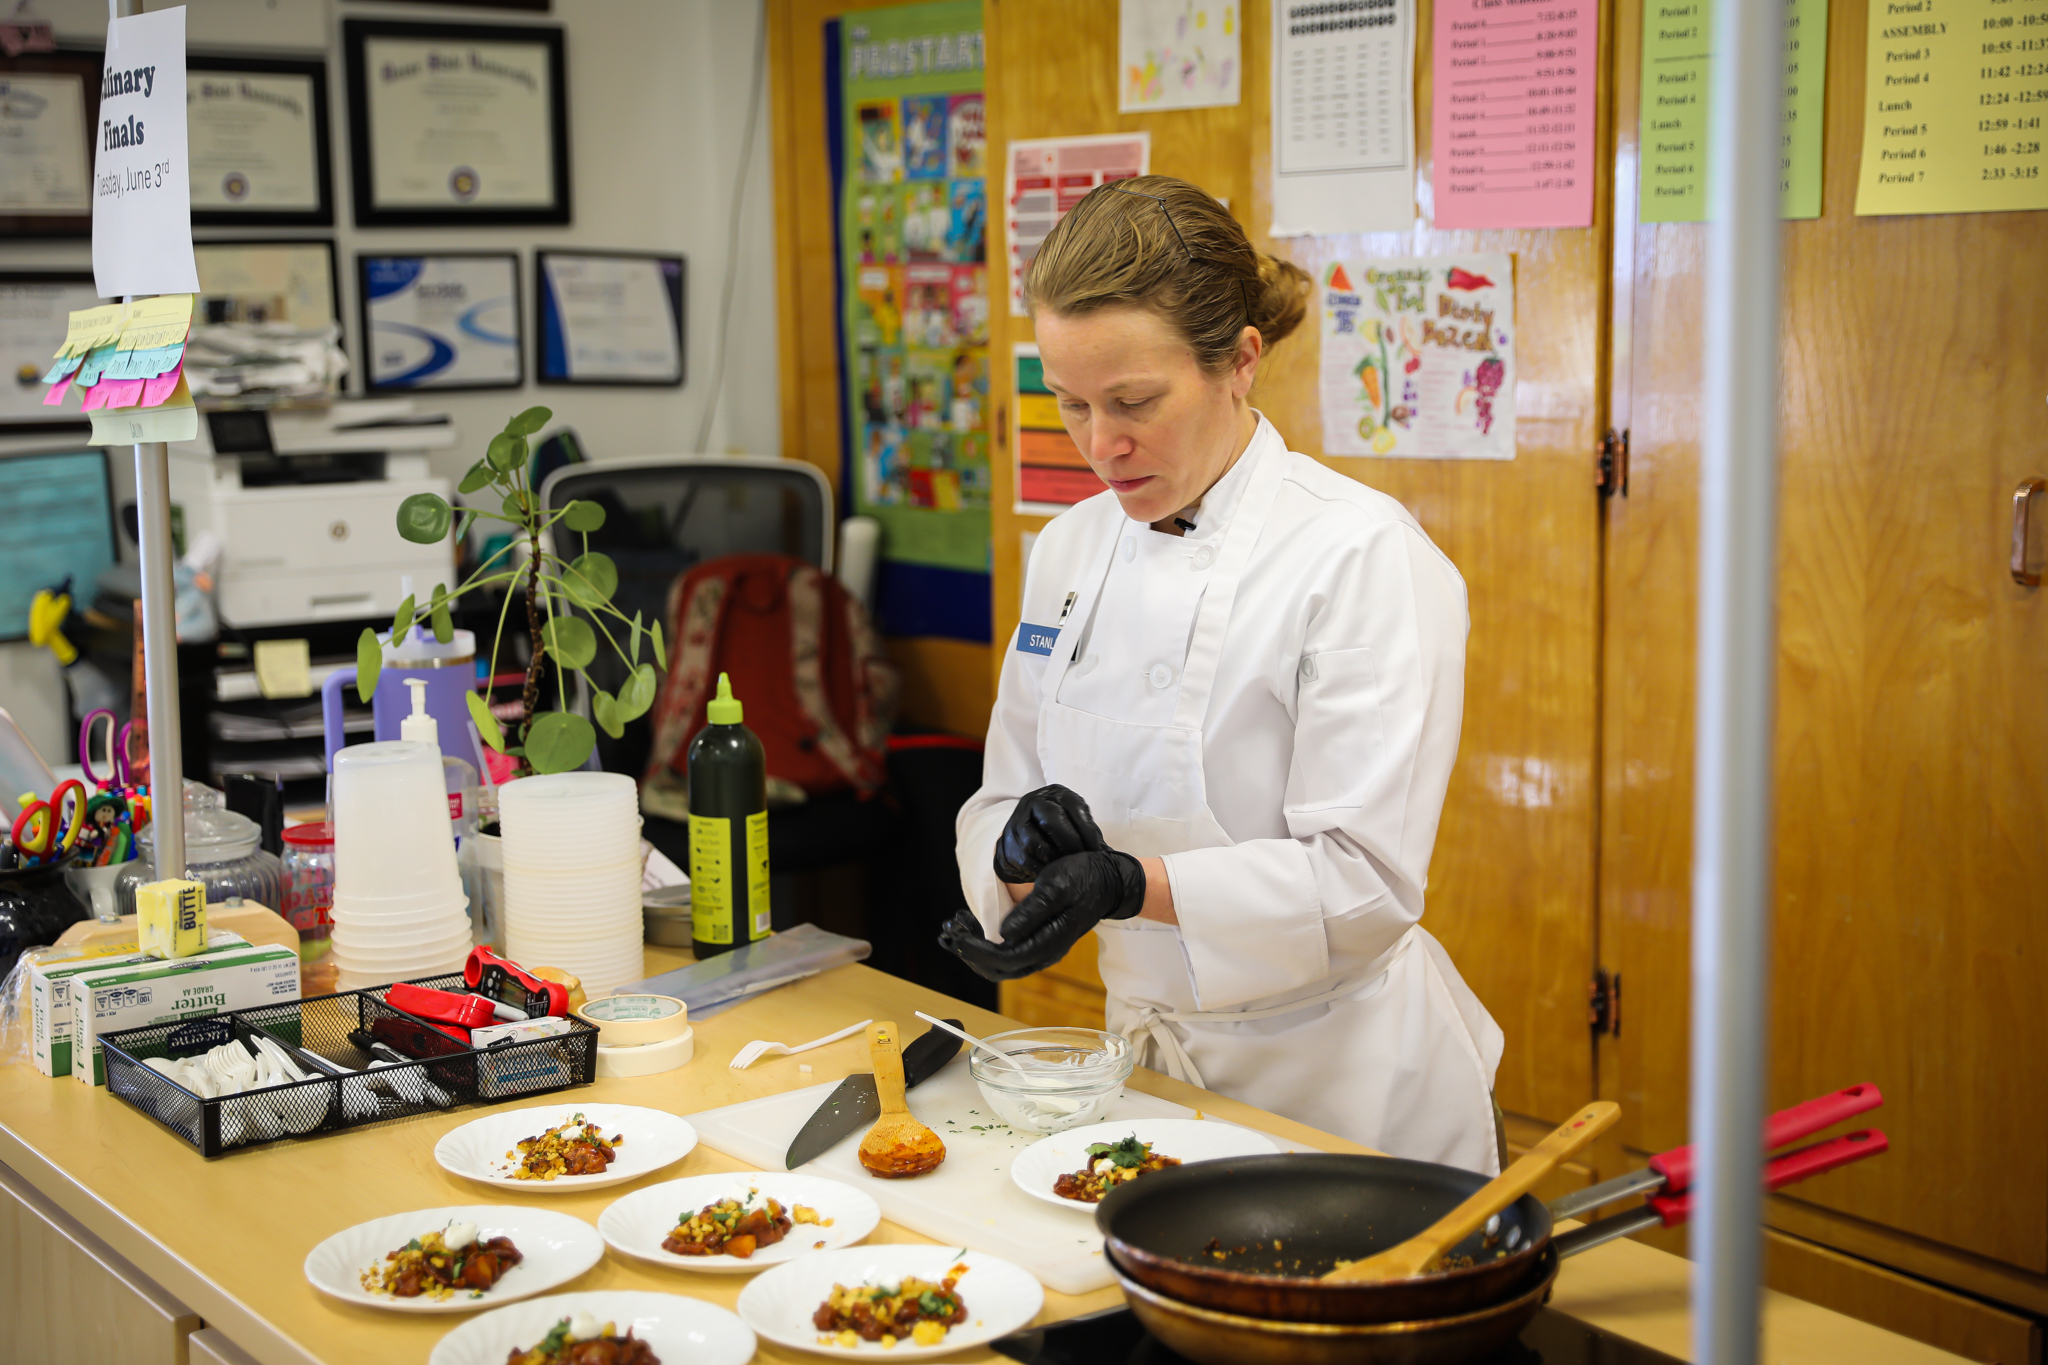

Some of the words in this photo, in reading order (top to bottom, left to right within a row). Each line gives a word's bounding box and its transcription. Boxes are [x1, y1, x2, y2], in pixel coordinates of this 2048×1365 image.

[1660, 7, 1690, 18] Period
[1692, 6, 1697, 15] 1
[1887, 0, 1922, 14] Period
[1926, 0, 1932, 11] 2
[1659, 28, 1690, 40] Period
[1692, 27, 1697, 38] 2
[1881, 22, 1947, 39] ASSEMBLY
[1983, 17, 2013, 30] 10:00
[2017, 14, 2048, 27] -10:5
[1886, 49, 1921, 62] Period
[1924, 48, 1930, 60] 3
[1982, 41, 2012, 54] 10:55
[1658, 73, 1688, 84] Period
[1691, 71, 1696, 82] 3
[1885, 73, 1920, 86] Period
[1923, 73, 1929, 83] 4
[1980, 66, 2011, 79] 11:42
[1657, 95, 1688, 106] Period
[1691, 95, 1696, 104] 4
[1879, 99, 1912, 113] Lunch
[1979, 92, 2009, 105] 12:24
[1651, 119, 1682, 130] Lunch
[1883, 125, 1918, 137] Period
[1922, 124, 1927, 135] 5
[1978, 119, 2008, 132] 12:59
[104, 115, 144, 151] Finals
[1656, 142, 1687, 153] Period
[1689, 141, 1694, 150] 5
[1881, 148, 1916, 160] Period
[1920, 147, 1926, 159] 6
[1983, 143, 2007, 156] 1:46
[1655, 164, 1686, 175] Period
[1688, 164, 1694, 173] 6
[1878, 172, 1914, 183] Period
[1918, 171, 1925, 182] 7
[1982, 168, 2005, 180] 2:33
[97, 171, 124, 198] Tuesday,
[127, 167, 151, 190] June
[155, 159, 170, 188] 3rd
[1655, 186, 1686, 197] Period
[1688, 185, 1694, 195] 7
[1030, 634, 1054, 649] STANL
[183, 988, 191, 996] AA
[193, 985, 214, 994] GRADE
[139, 995, 150, 1003] 100
[171, 993, 226, 1011] Butter
[183, 1008, 215, 1018] UNSALTED
[171, 1028, 229, 1048] Lucerne
